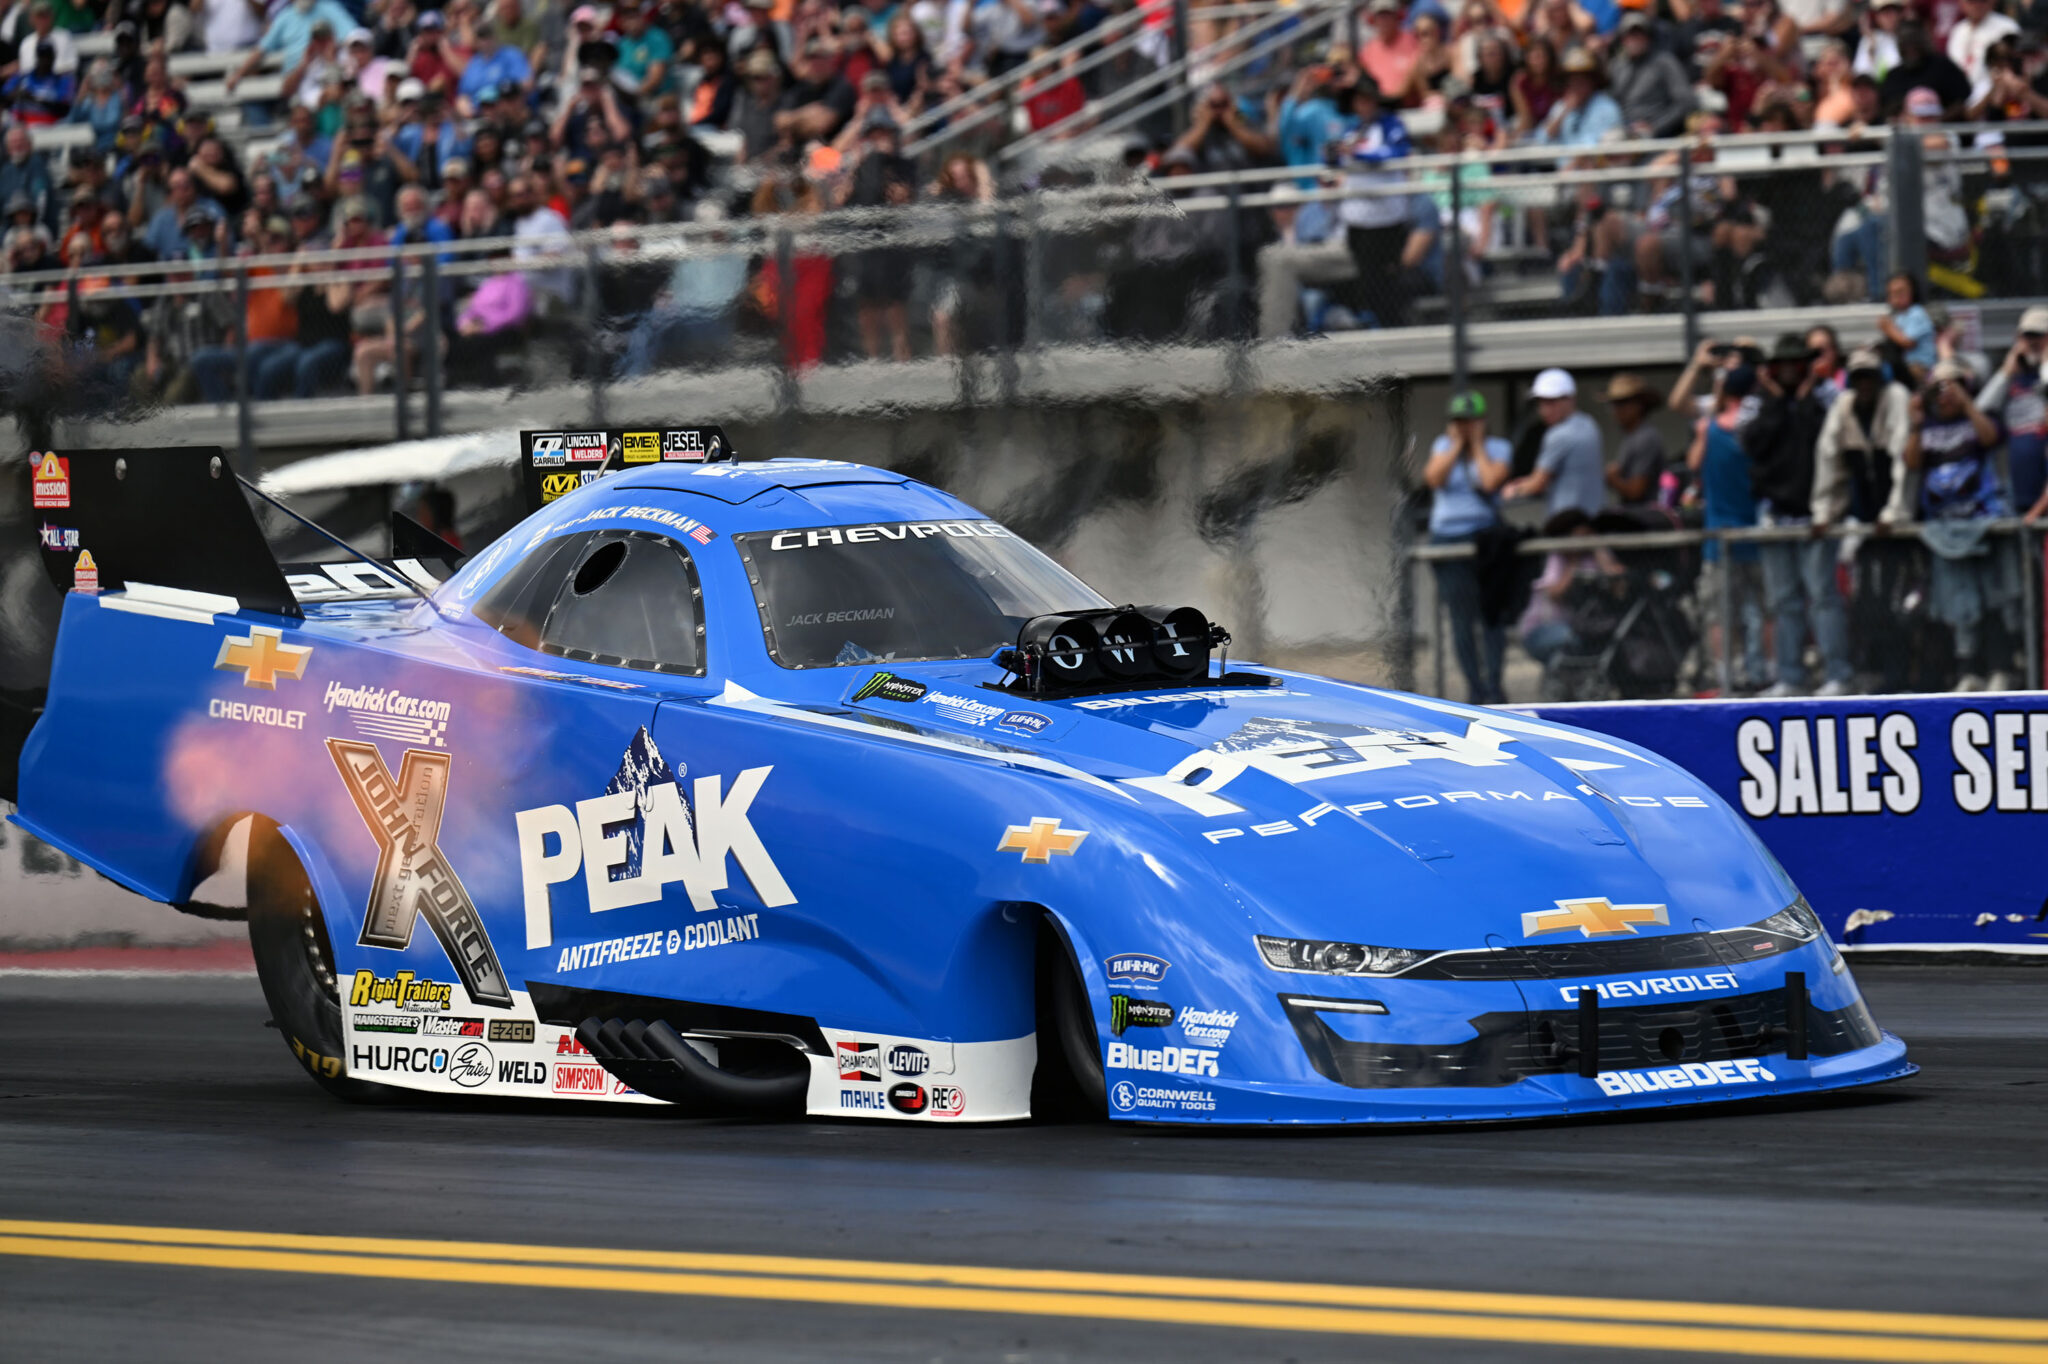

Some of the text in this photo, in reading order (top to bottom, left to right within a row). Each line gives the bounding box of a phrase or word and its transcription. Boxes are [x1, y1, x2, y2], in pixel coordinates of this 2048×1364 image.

[566, 434, 600, 448] LINCOLN
[624, 436, 652, 448] BME
[664, 433, 703, 451] JESEL
[533, 457, 565, 466] CARRILLO
[574, 449, 603, 460] WELDERS
[578, 506, 628, 523] JACK
[619, 505, 702, 533] BECKMAN
[50, 529, 79, 547] ALL STAR
[770, 522, 1013, 550] CHEVROLE
[785, 607, 895, 627] JACK BECKMAN
[883, 681, 926, 697] MONSTER
[208, 698, 307, 730] CHEVROLET
[1114, 721, 1625, 818] PEAK
[1736, 712, 1922, 818] SALES
[515, 765, 799, 950] PEAK
[353, 762, 493, 983] JOHN FORCE
[385, 884, 406, 932] next
[557, 913, 760, 973] ANTIFREEZE & COOLANT
[1559, 972, 1739, 1003] CHEVROLET
[403, 1001, 441, 1013] Nationwide
[1128, 1005, 1171, 1017] MONSTER
[1177, 1006, 1239, 1028] Hendrick
[354, 1014, 419, 1027] HANGSTERFER'S
[424, 1016, 484, 1036] Mastercam
[1184, 1023, 1231, 1039] Cars.com
[353, 1044, 449, 1074] HURCO
[450, 1048, 491, 1081] Gates
[840, 1054, 879, 1069] CHAMPION
[886, 1045, 929, 1073] CLEVITE
[1107, 1042, 1219, 1076] BlueDEF
[499, 1060, 547, 1084] WELD
[555, 1066, 604, 1091] SIMPSON
[1594, 1058, 1761, 1097] BlueDEF
[840, 1089, 885, 1110] MAHLE
[1137, 1099, 1216, 1111] QUALITY TOOLS
[1138, 1087, 1213, 1102] CORNWELL
